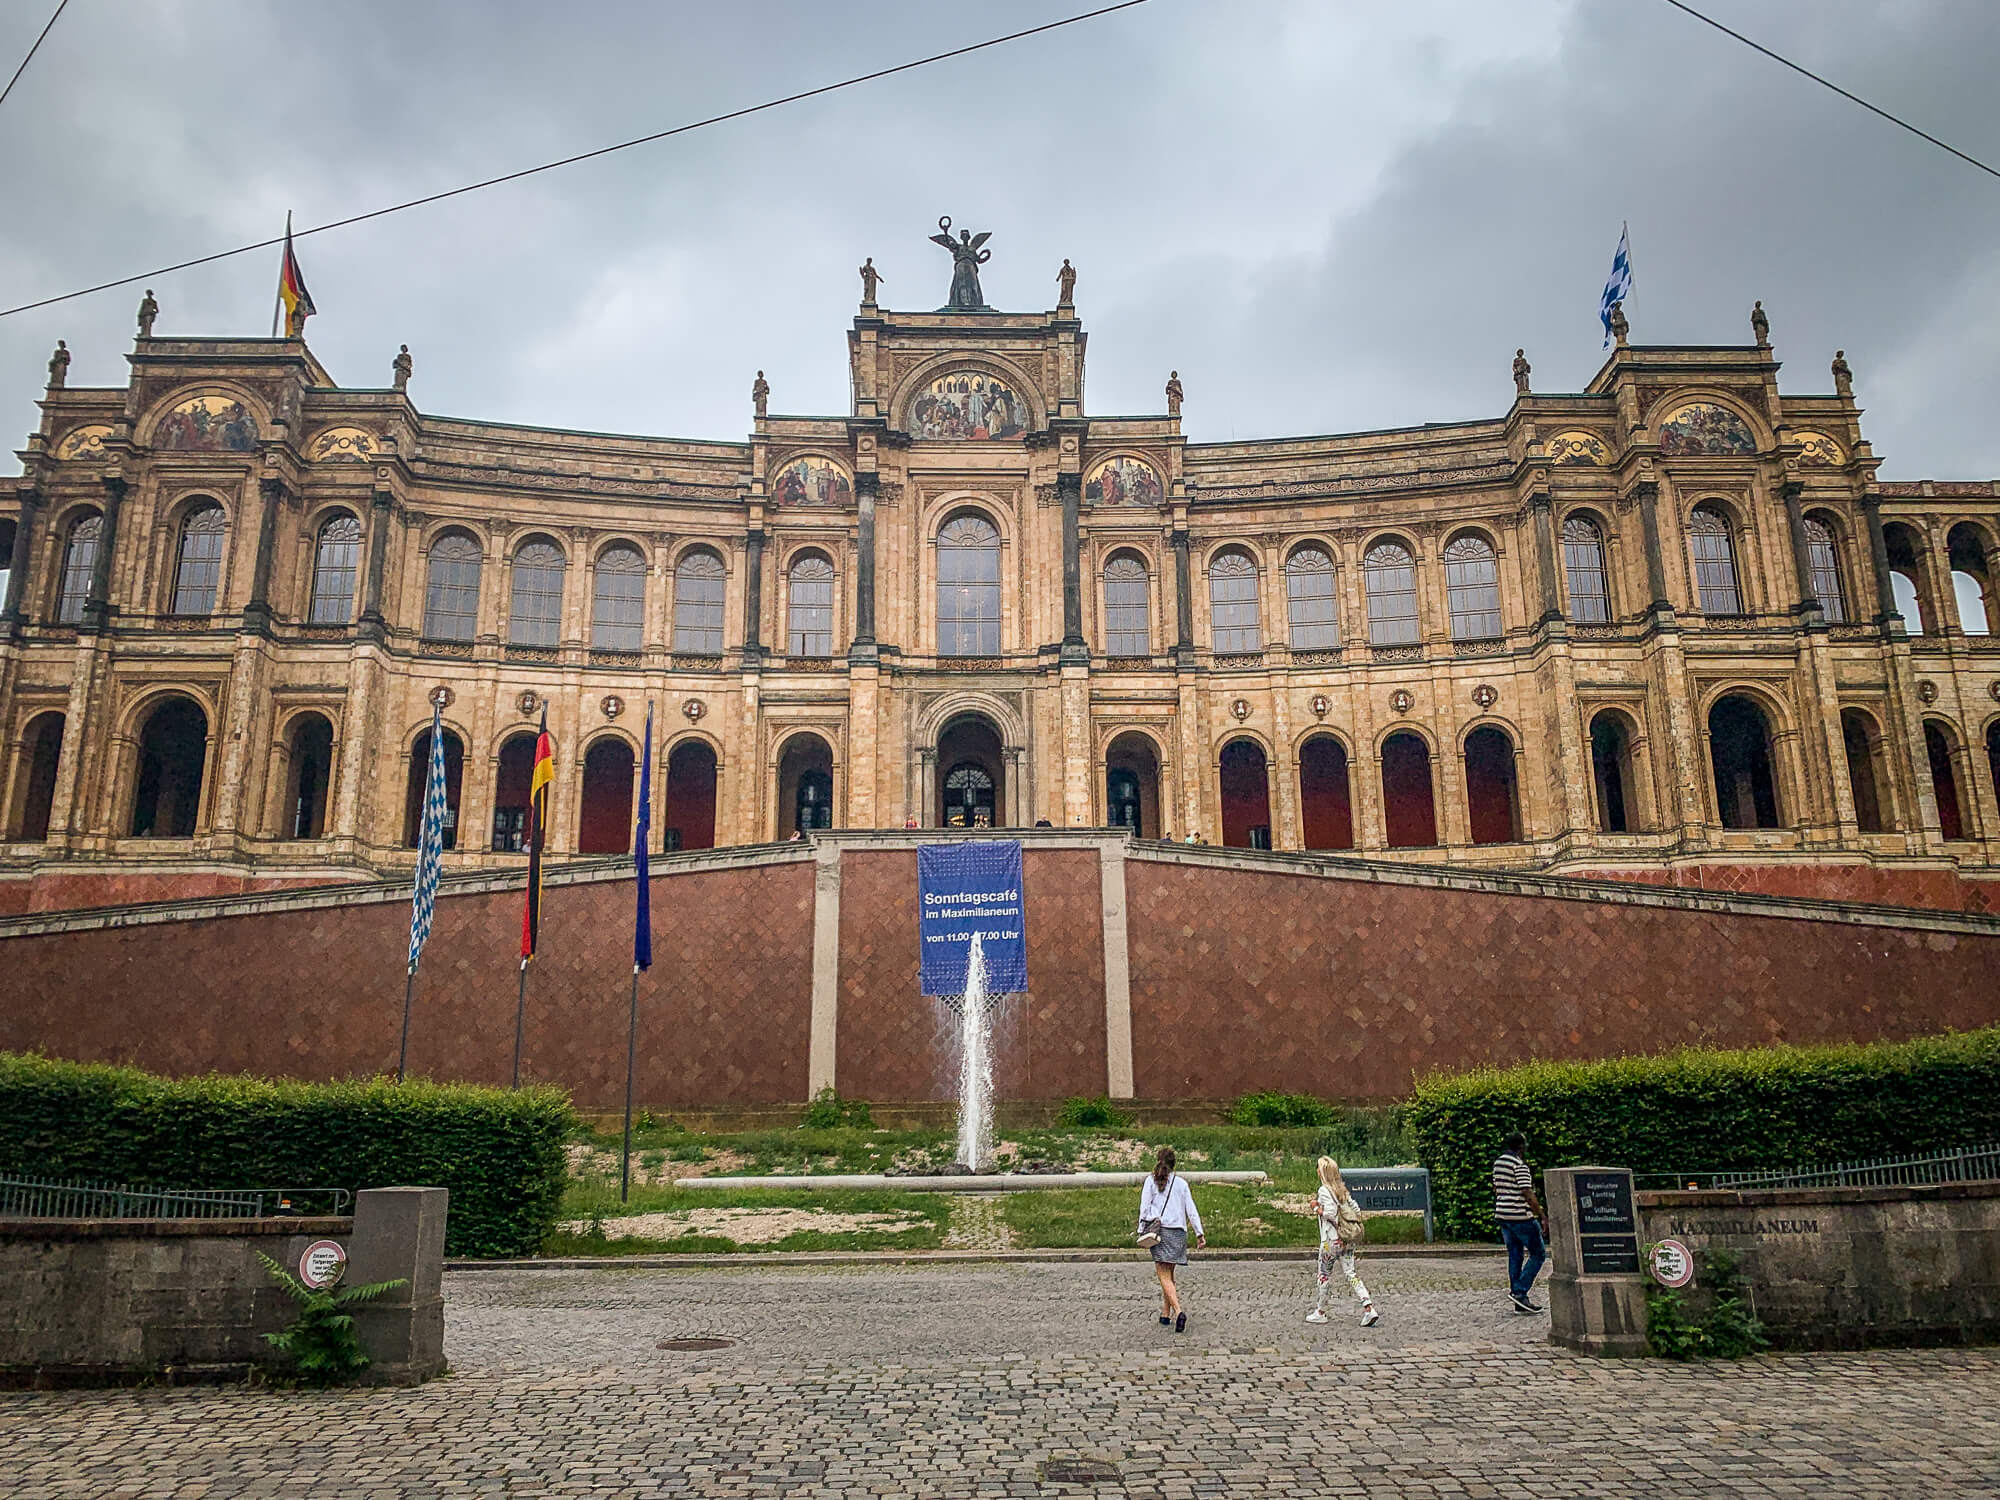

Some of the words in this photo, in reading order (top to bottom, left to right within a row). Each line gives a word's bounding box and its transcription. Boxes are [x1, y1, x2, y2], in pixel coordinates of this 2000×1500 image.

[924, 889, 1018, 905] Sonntagscafé
[925, 909, 939, 919] im
[941, 907, 1019, 918] Maximilianeum
[926, 934, 944, 943] von
[946, 932, 969, 942] 11.00
[975, 931, 1000, 941] 7.00
[1001, 930, 1019, 940] Uhr
[1669, 1219, 1819, 1236] MAXIMILIANEUM
